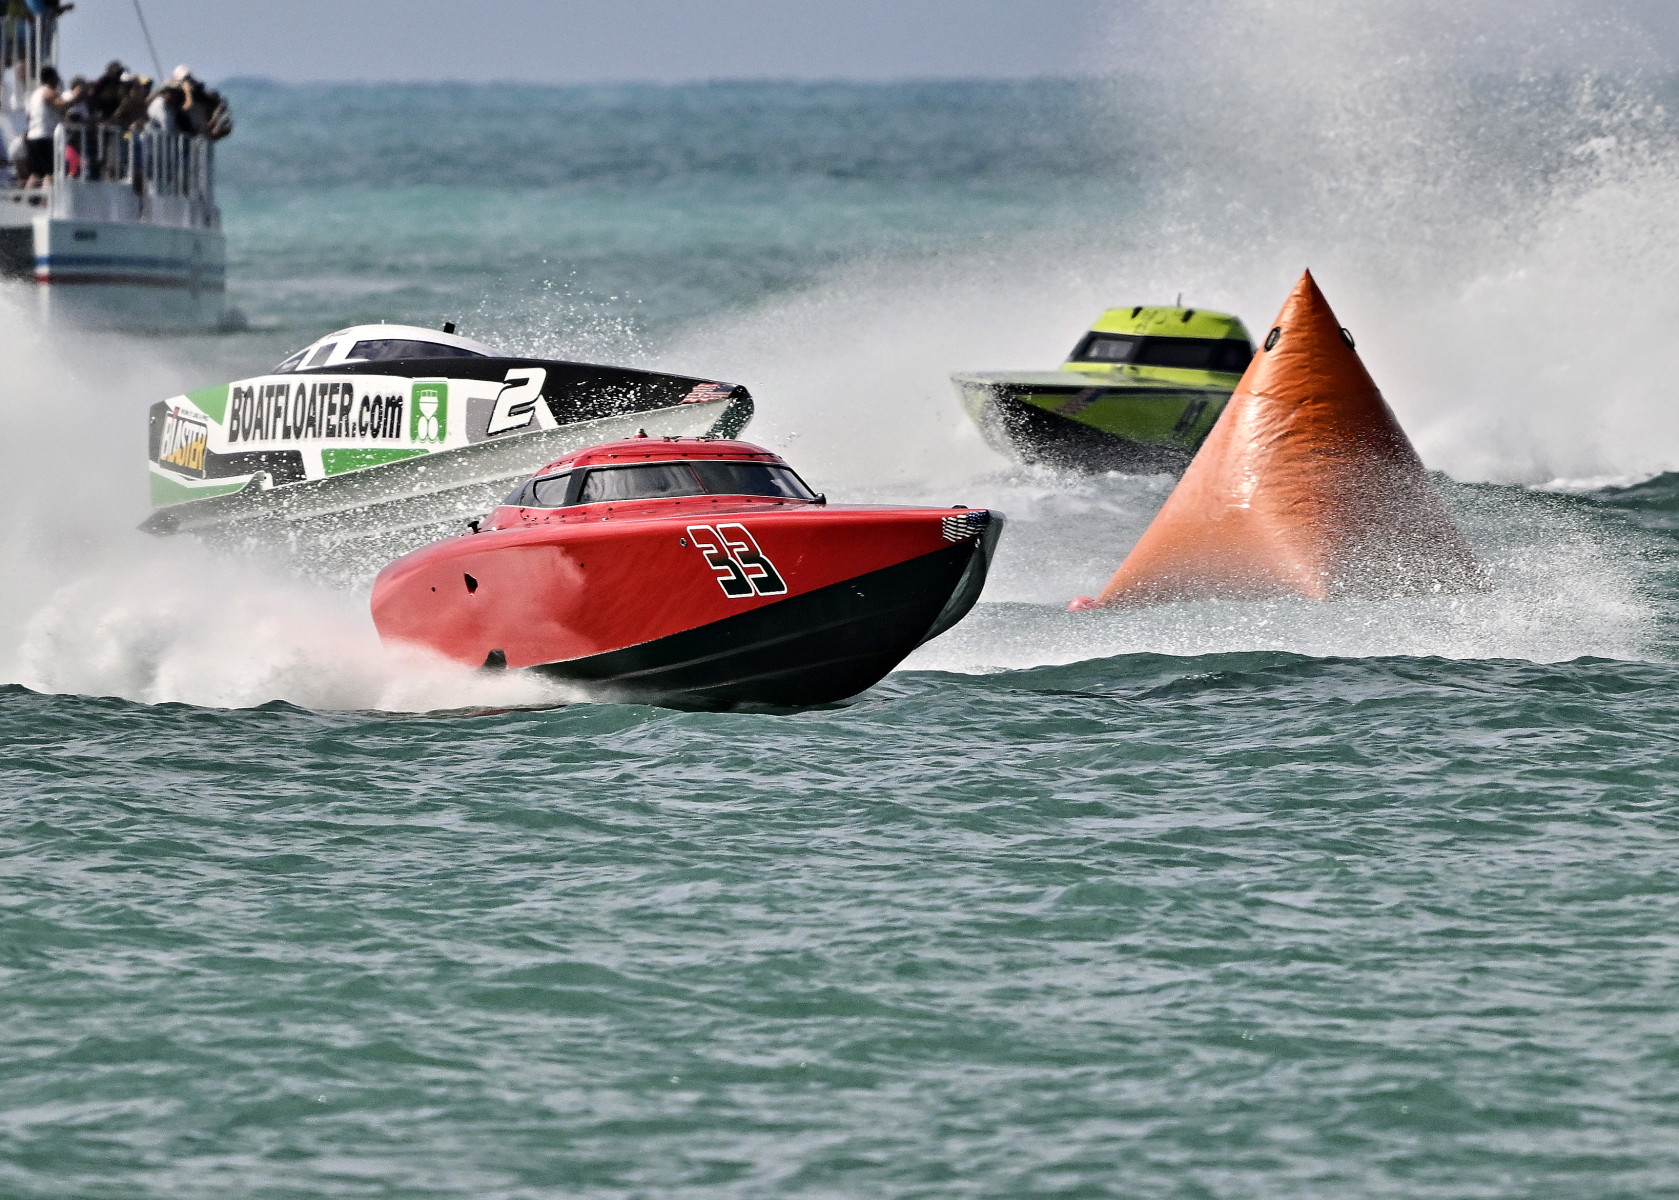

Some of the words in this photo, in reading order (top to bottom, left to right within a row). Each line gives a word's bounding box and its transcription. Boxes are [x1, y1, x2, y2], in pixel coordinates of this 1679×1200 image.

[228, 382, 404, 443] BOATFLOATER.com
[487, 367, 547, 436] 2
[686, 523, 788, 599] 33
